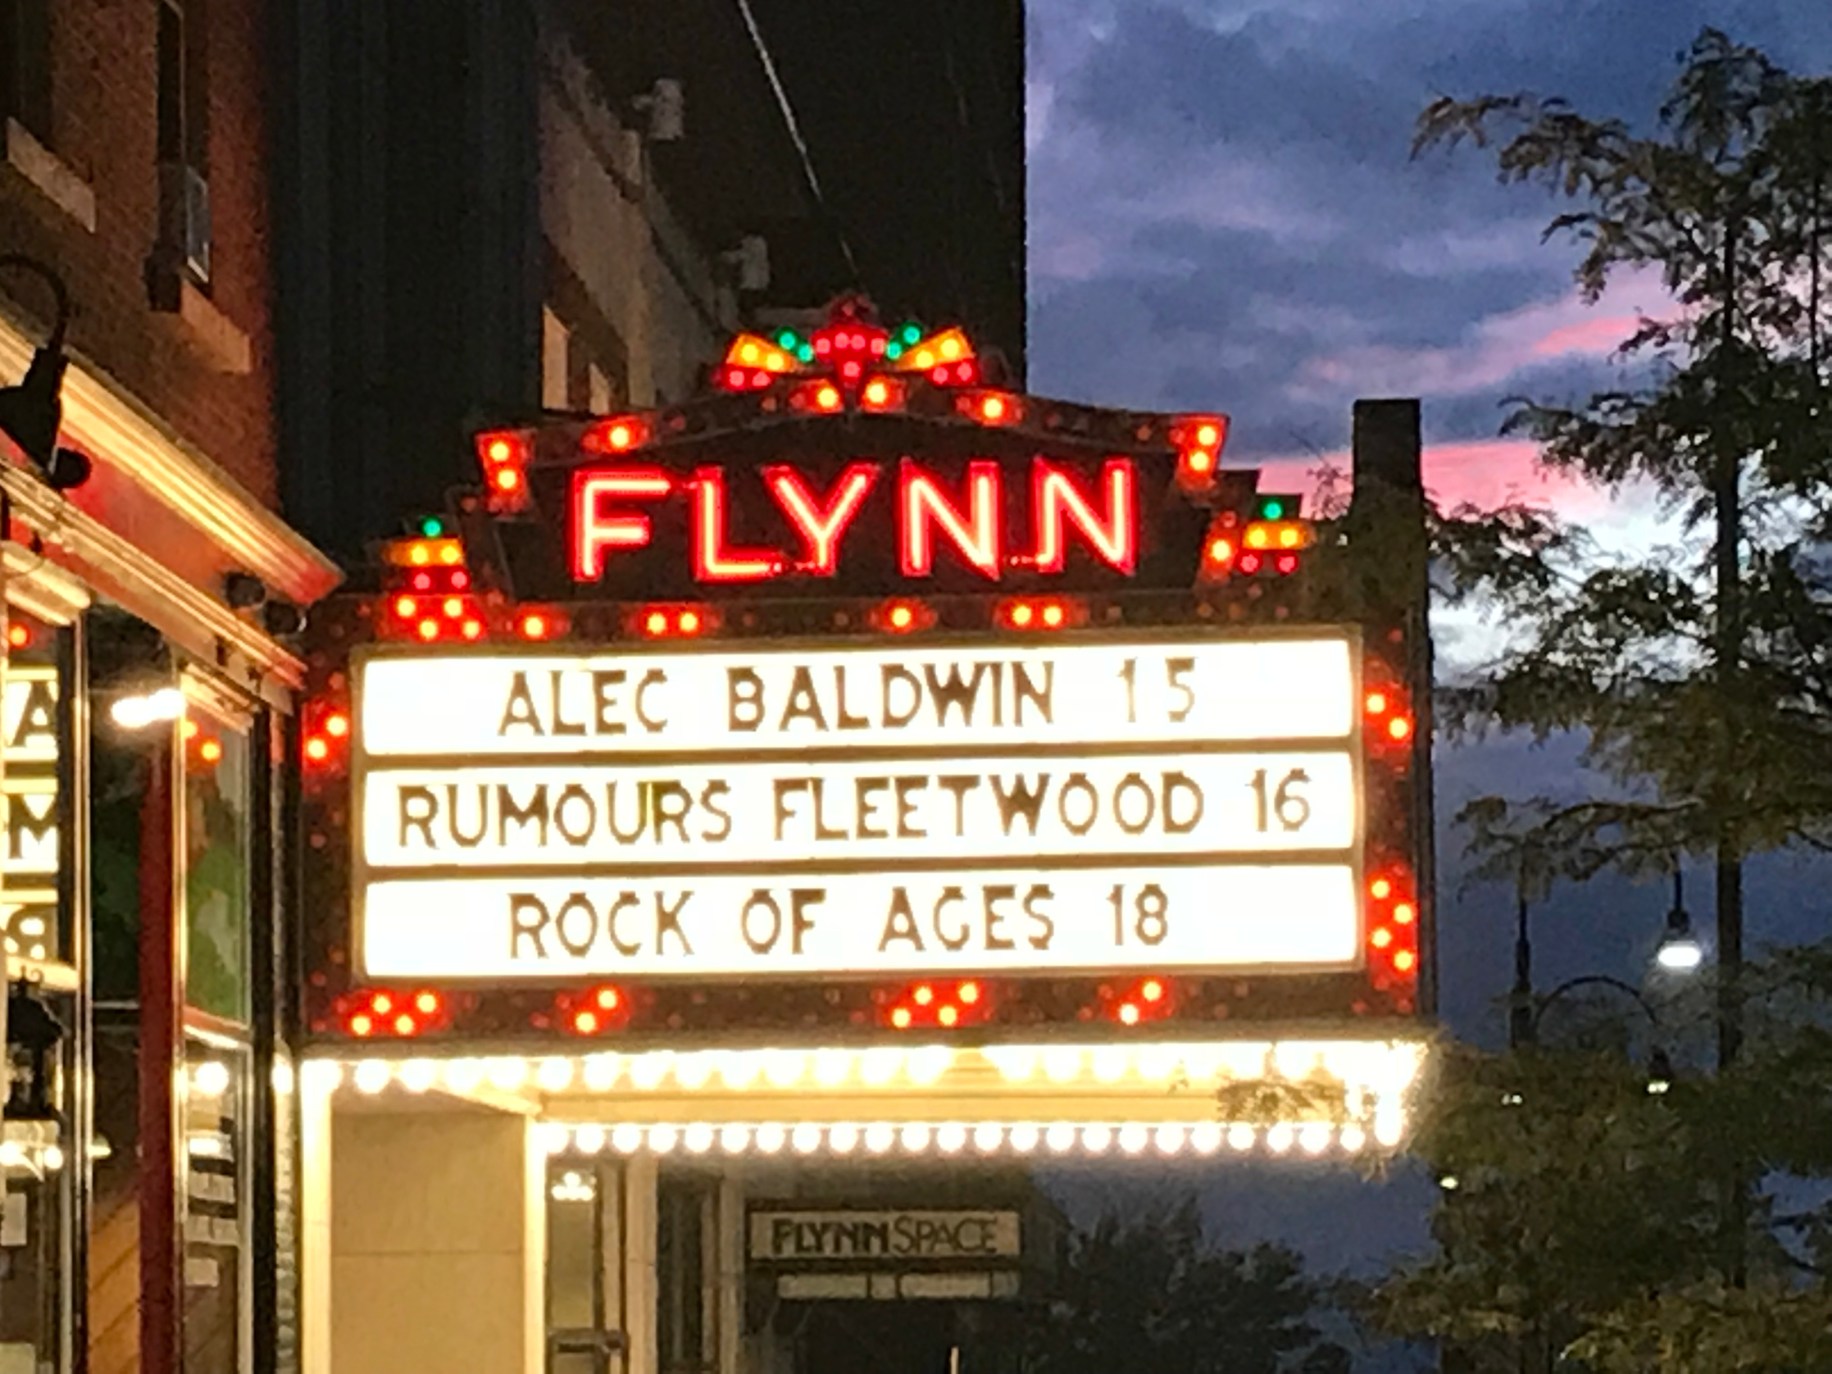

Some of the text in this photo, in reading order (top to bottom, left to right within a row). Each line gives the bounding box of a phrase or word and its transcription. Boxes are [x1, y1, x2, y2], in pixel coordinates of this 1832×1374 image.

[573, 456, 1136, 581] FLYNN
[498, 668, 667, 736] ALEC
[726, 661, 1054, 732] BALDWIN
[397, 768, 1310, 849] RUMOURS FLEETWOOD 16
[508, 883, 1168, 959] ROCK OF AGES 18
